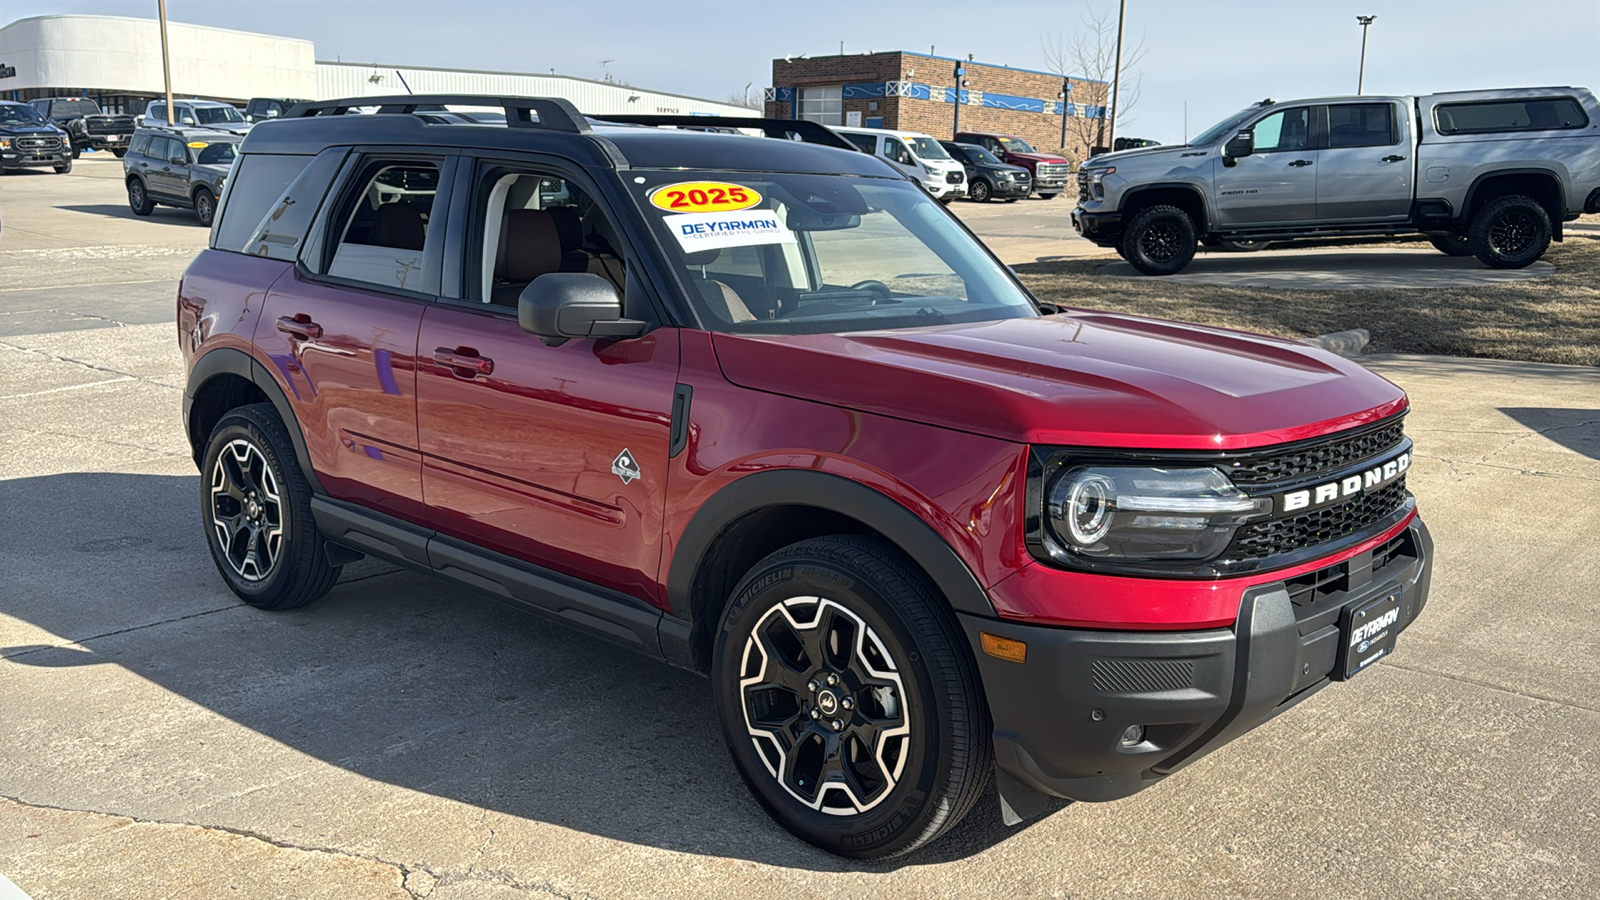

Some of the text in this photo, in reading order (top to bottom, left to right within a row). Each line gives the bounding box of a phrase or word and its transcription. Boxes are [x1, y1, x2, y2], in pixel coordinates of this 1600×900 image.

[666, 187, 749, 208] 2025
[681, 219, 778, 236] DEYARMAN
[692, 228, 781, 240] CERTIFIED PRE-OWNED
[258, 438, 284, 483] MICHELIN
[1283, 453, 1410, 512] BRONCO
[740, 567, 792, 607] MICHELIN
[1350, 607, 1400, 648] DEYARMAN
